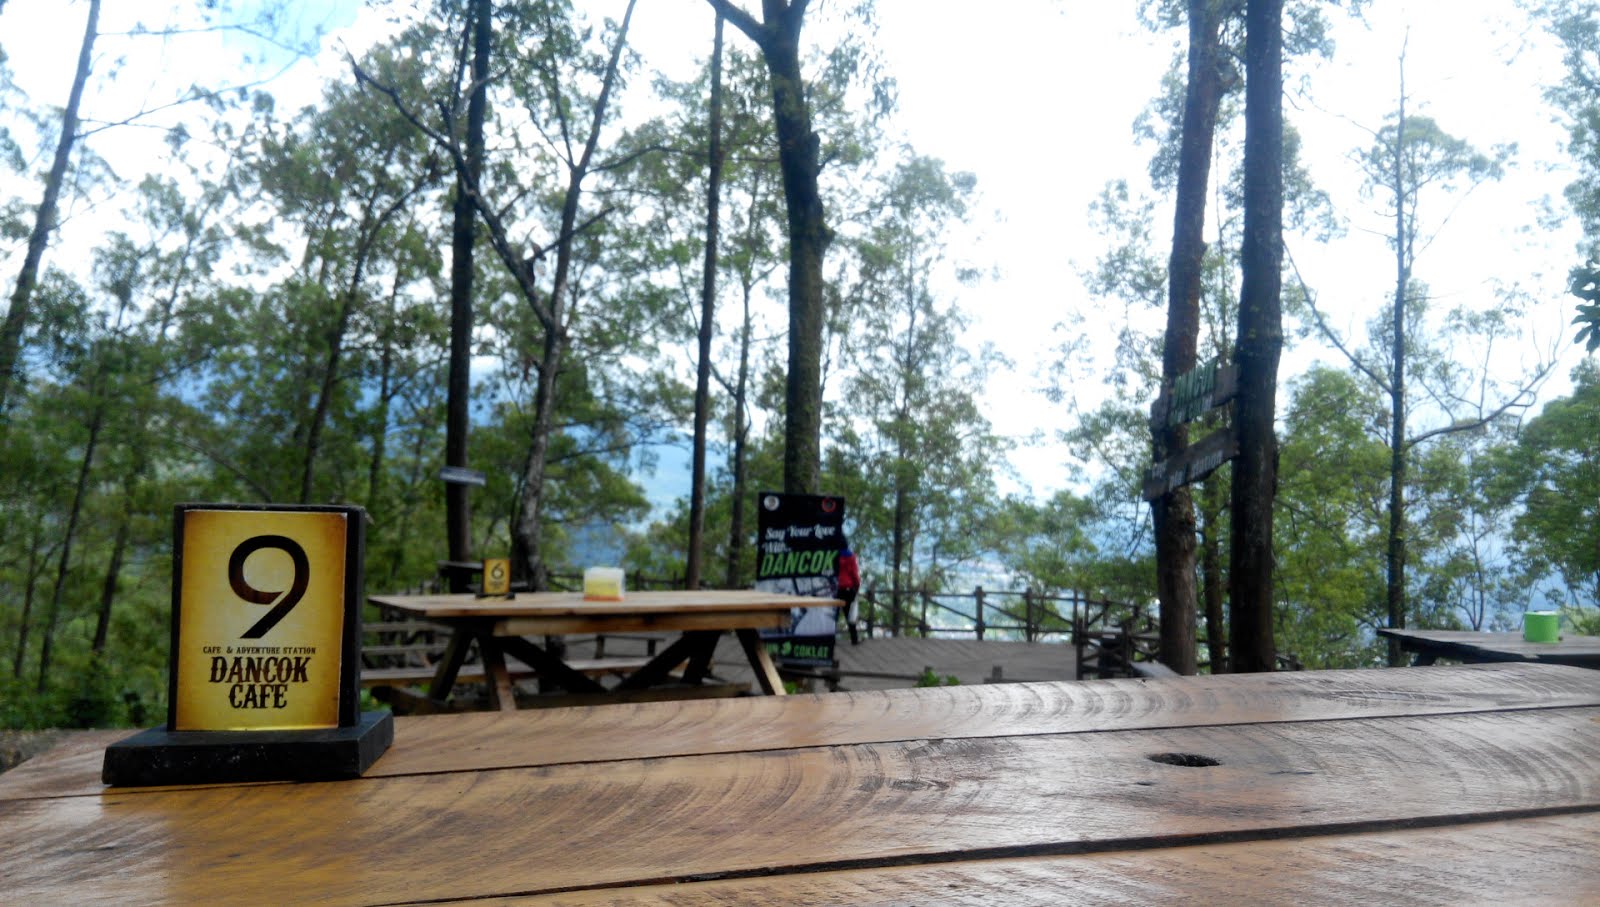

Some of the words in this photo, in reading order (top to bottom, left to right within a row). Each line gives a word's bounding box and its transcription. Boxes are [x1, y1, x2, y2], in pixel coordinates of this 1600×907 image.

[765, 527, 785, 542] Say
[814, 523, 836, 540] Love
[491, 562, 504, 580] 6
[760, 550, 839, 577] DANCOK
[228, 534, 310, 639] 9
[203, 646, 221, 654] CAFE
[226, 646, 233, 654] &
[236, 646, 280, 655] ADVENTURE
[283, 646, 316, 655] STATION
[208, 656, 311, 683] DANCOK
[228, 683, 288, 709] CAFE
